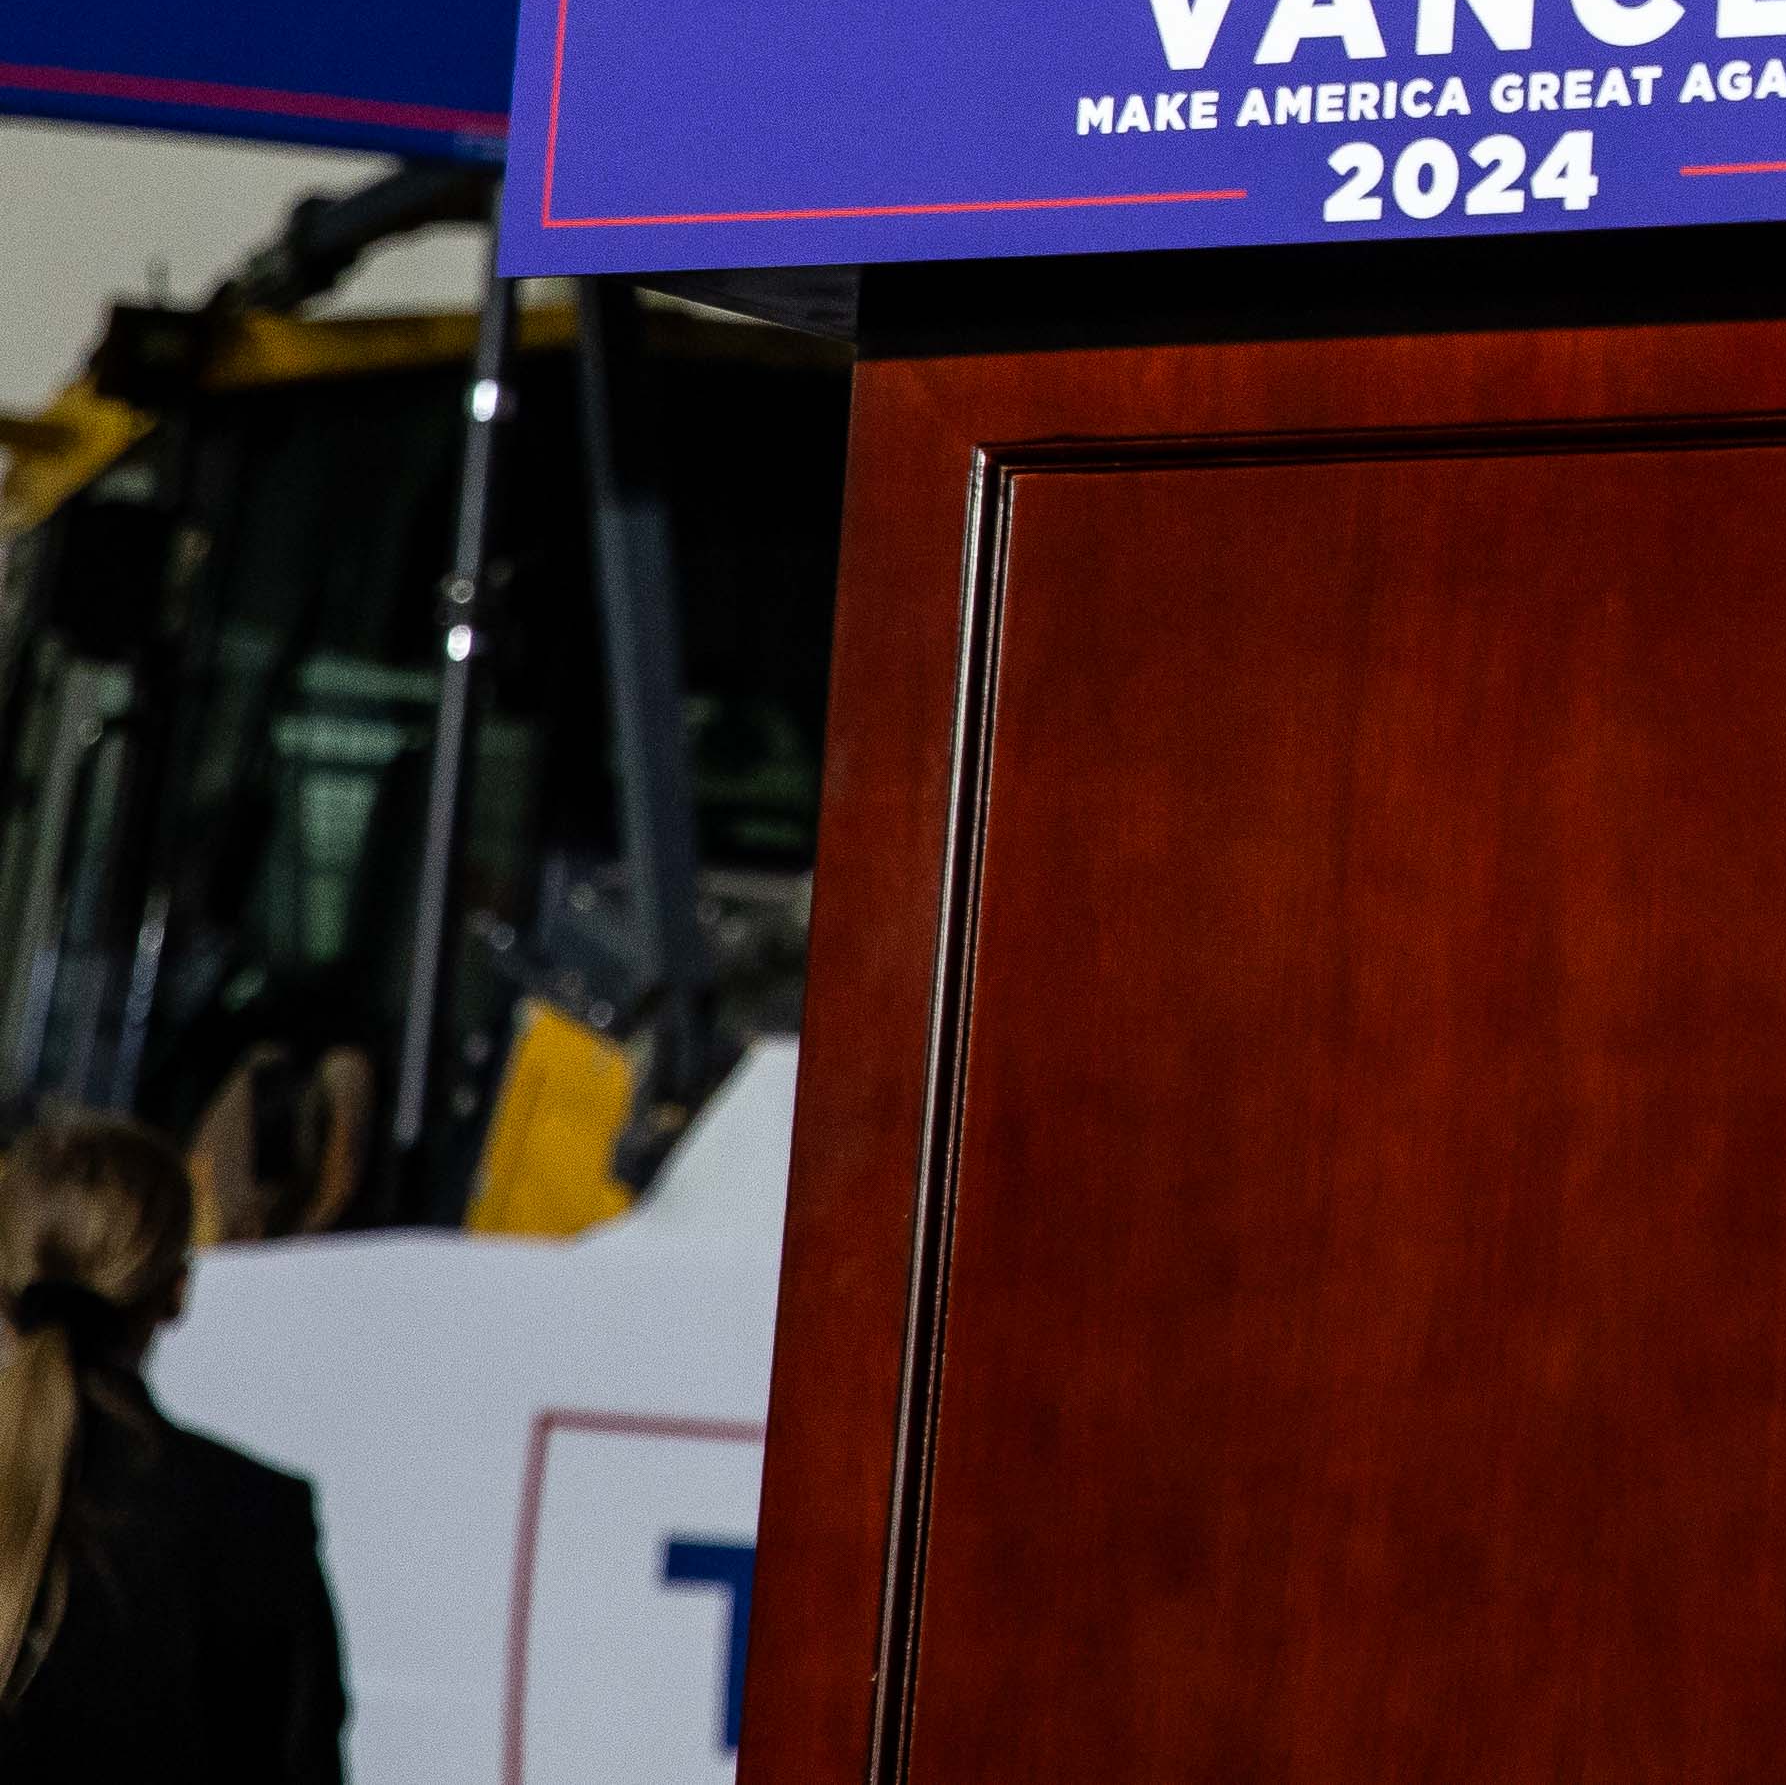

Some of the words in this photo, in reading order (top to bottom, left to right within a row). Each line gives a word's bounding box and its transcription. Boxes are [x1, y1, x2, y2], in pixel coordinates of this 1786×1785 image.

[1075, 89, 1221, 137] MAKE
[1235, 75, 1472, 128] AMERICA
[1489, 64, 1664, 114] GREAT
[1322, 129, 1600, 223] 2024
